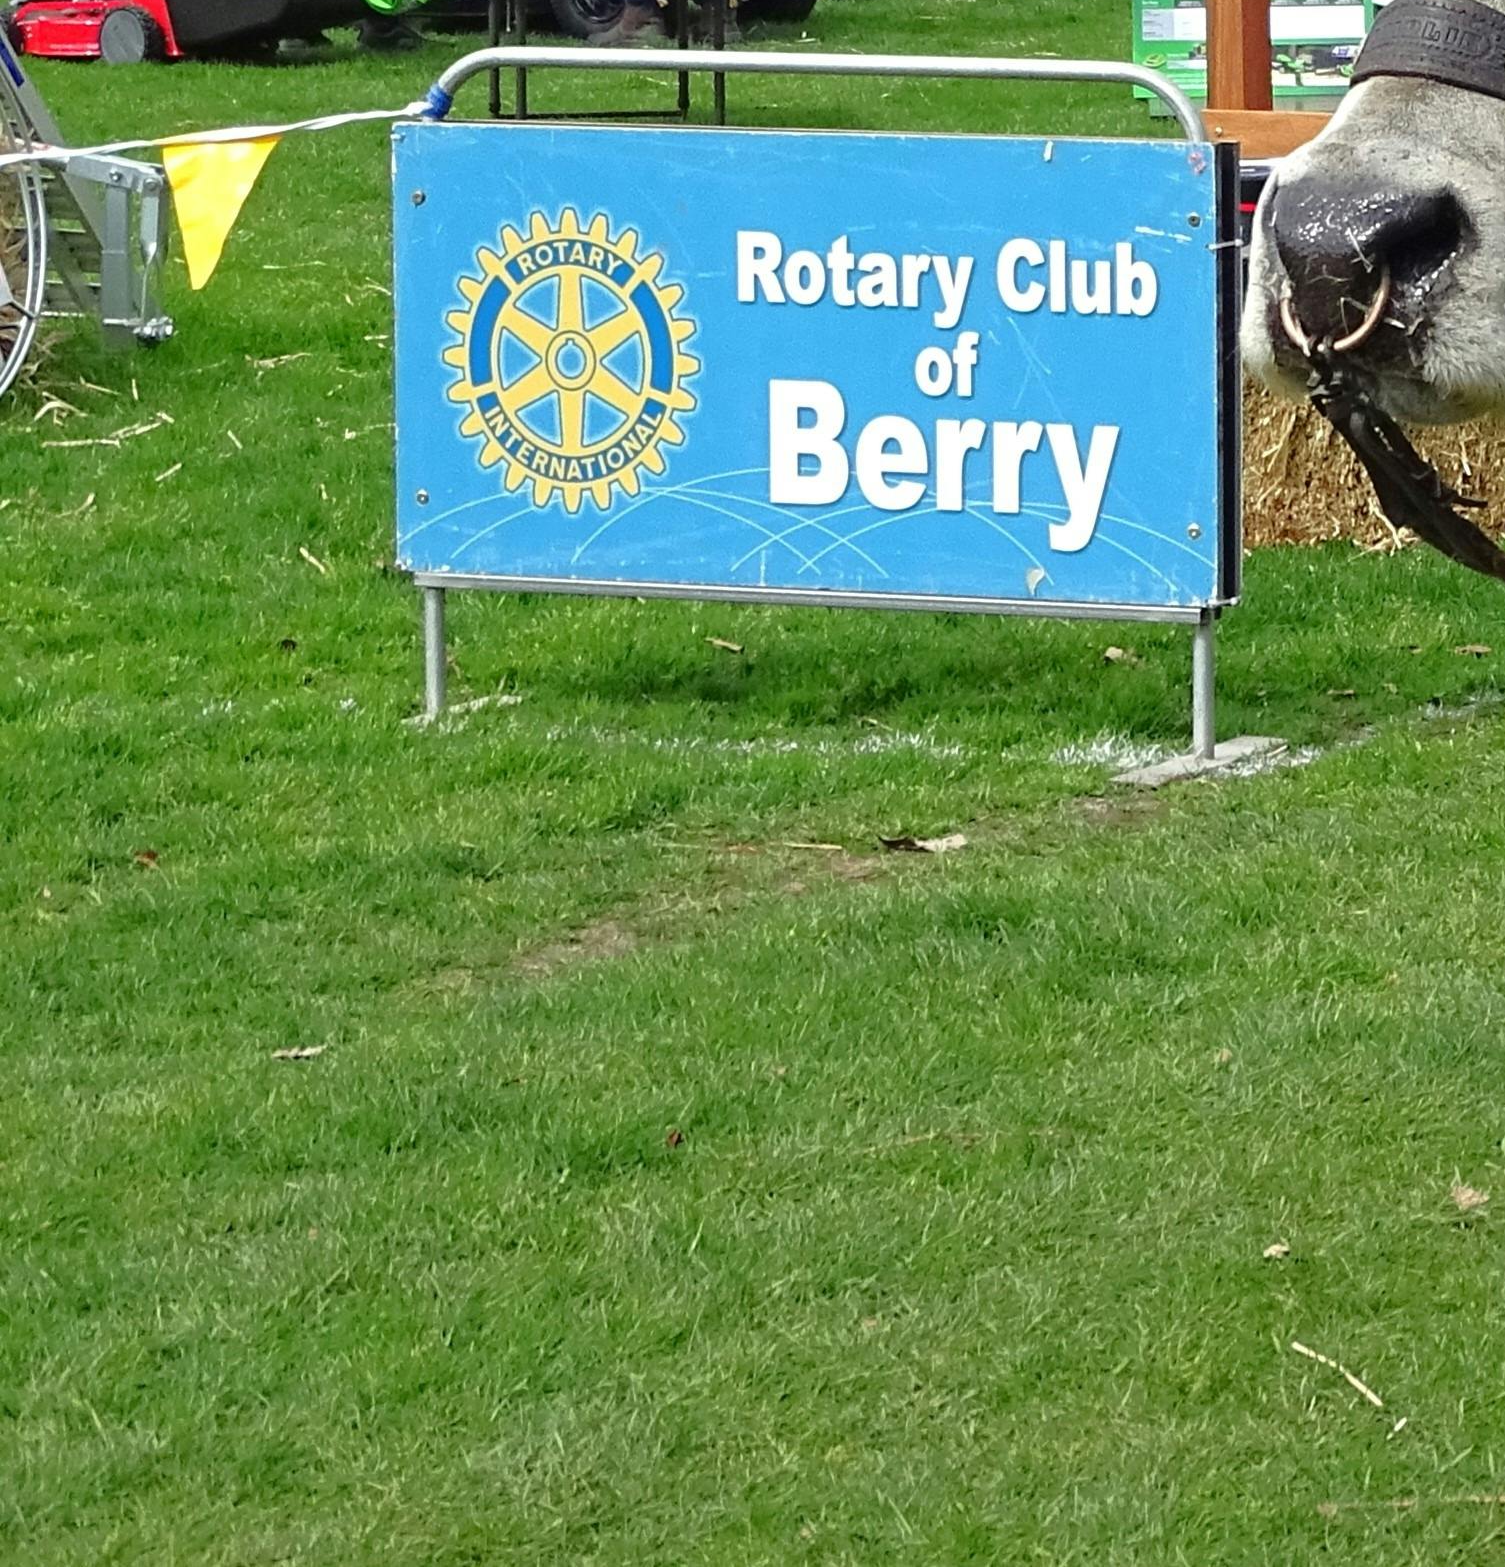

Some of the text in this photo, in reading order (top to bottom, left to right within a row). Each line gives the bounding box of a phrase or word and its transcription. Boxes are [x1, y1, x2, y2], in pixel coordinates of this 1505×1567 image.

[518, 241, 625, 278] ROTARY
[736, 230, 1158, 328] Rotary Club
[915, 331, 979, 398] of
[483, 406, 663, 480] INTERNATIONAL
[768, 378, 1120, 552] Berry
